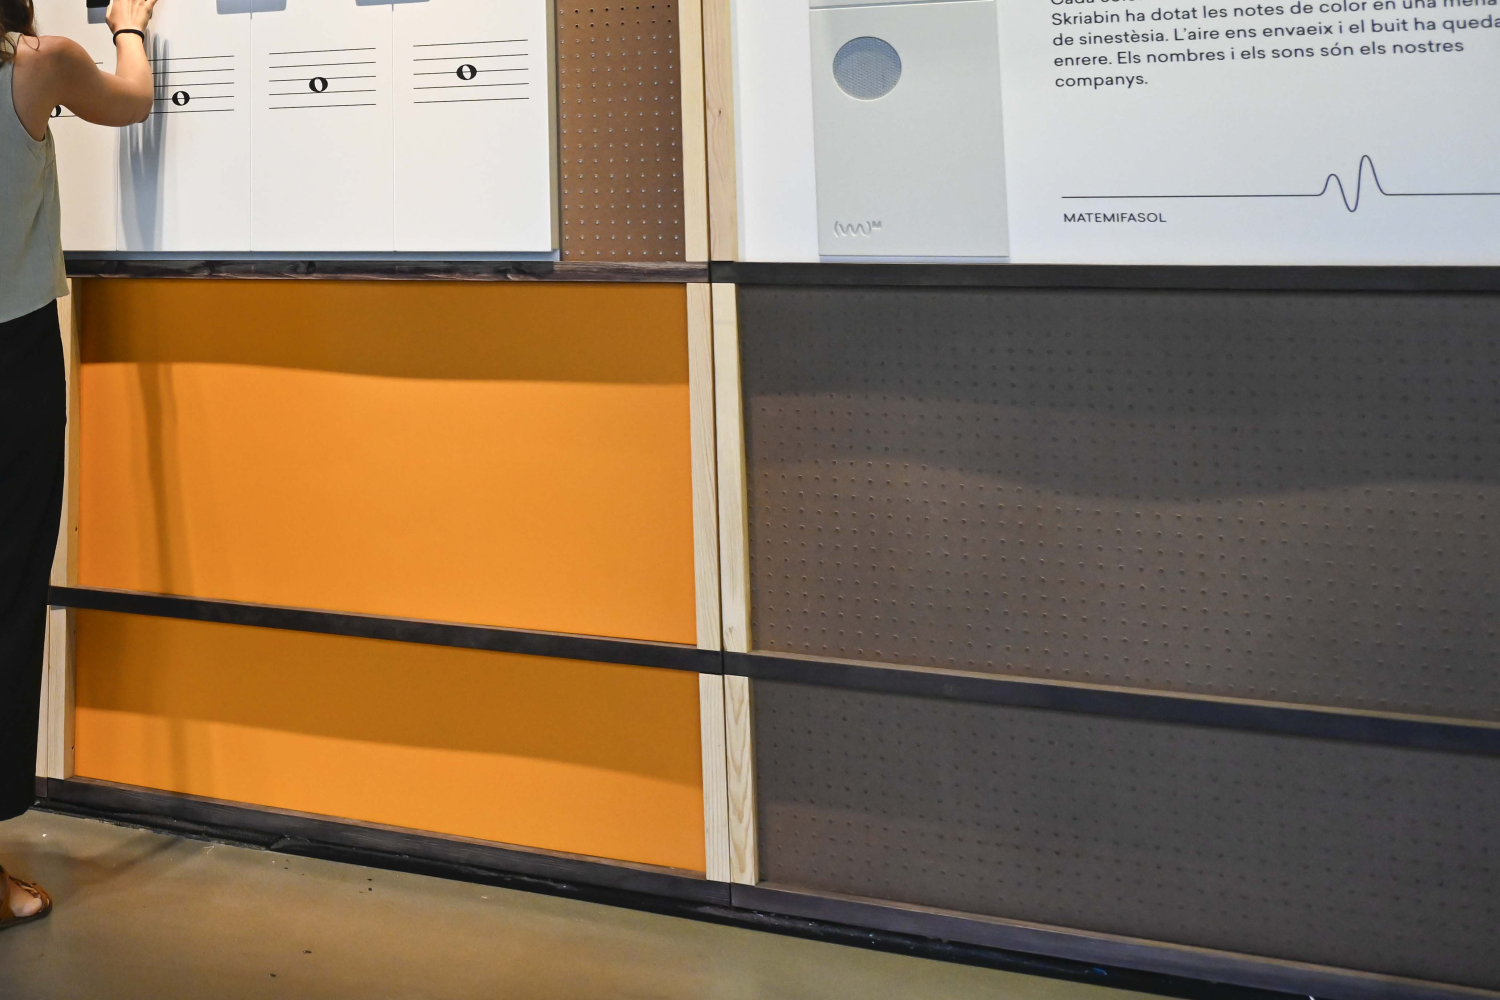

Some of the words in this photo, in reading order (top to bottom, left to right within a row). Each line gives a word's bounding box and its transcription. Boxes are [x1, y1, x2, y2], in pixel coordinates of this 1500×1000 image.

[1051, 10, 1120, 26] Skriabin
[1125, 8, 1146, 23] ha
[1150, 6, 1199, 22] dotat
[1202, 5, 1228, 19] les
[1233, 3, 1285, 18] notes
[1289, 0, 1314, 15] de
[1372, 0, 1396, 11] en
[1052, 32, 1075, 47] de
[1078, 28, 1169, 46] sinestèsia.
[1224, 28, 1258, 39] ens
[1262, 21, 1334, 38] envaeix
[1338, 20, 1343, 35] i
[1348, 19, 1365, 34] el
[1370, 18, 1409, 33] buit
[1413, 17, 1437, 31] ha
[1053, 55, 1113, 67] enrere.
[1116, 50, 1142, 65] Els
[1146, 48, 1226, 64] nombres
[1230, 46, 1235, 60] i
[1240, 45, 1267, 60] els
[1271, 47, 1315, 59] sons
[1319, 41, 1355, 57] són
[1359, 40, 1387, 56] els
[1392, 39, 1465, 54] nostres
[1054, 75, 1148, 90] companys.
[1063, 212, 1167, 223] MATEMIFASOL
